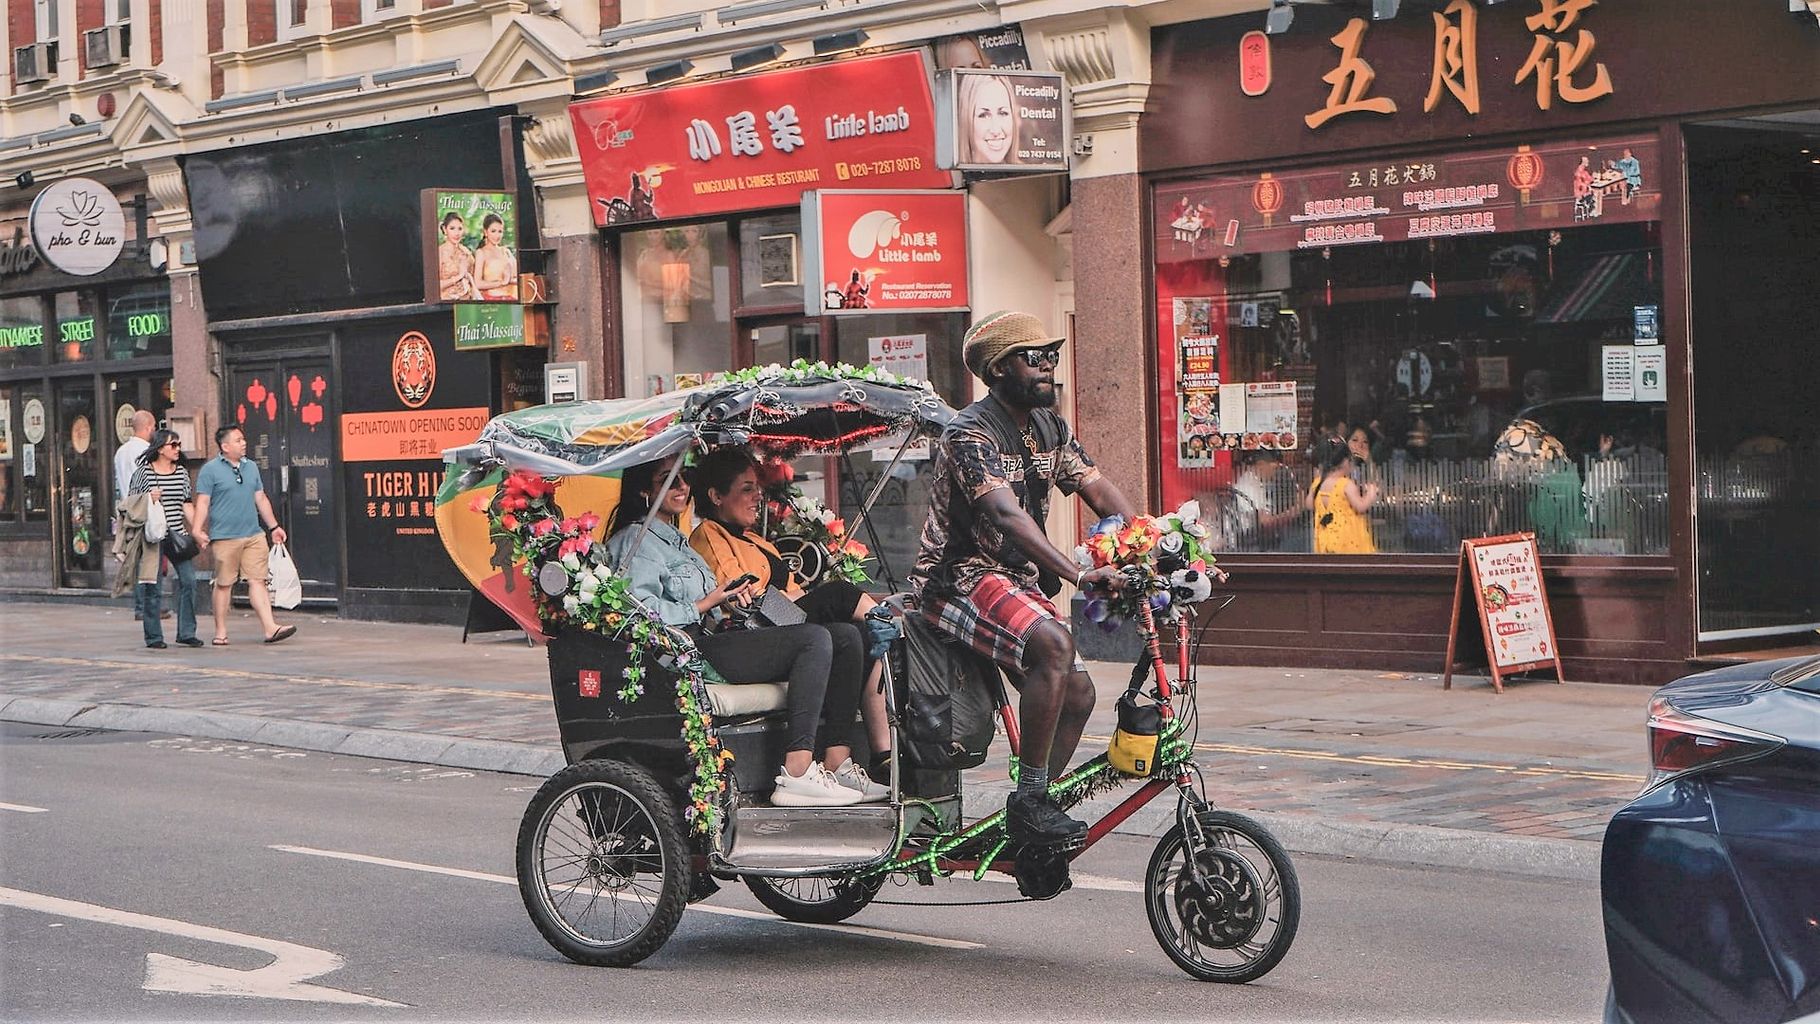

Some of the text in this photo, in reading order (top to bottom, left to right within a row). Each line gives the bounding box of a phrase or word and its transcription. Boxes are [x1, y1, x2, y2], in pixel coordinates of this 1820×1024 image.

[978, 30, 1022, 49] Piccadilly
[1304, 0, 1613, 129] 五月花
[1015, 84, 1059, 100] Piccadilly
[825, 106, 910, 140] Little lamb
[1020, 107, 1056, 119] Dental
[1032, 137, 1046, 147] Tel:
[1031, 150, 1045, 158] 7437
[850, 157, 921, 178] 020-7287 8078
[1348, 164, 1437, 188] 五月花火鍋
[693, 168, 820, 195] MONGOLIAN & CHINESE RESTURANT
[440, 195, 464, 209] Thai
[48, 229, 116, 250] pho & bun
[879, 249, 941, 262] Little lamb
[916, 283, 952, 291] Reservation
[0, 313, 161, 348] TNAMESE STREET FOOD
[457, 320, 524, 343] Thai Massage
[347, 416, 489, 436] CHINATOWN OPENING SOON
[400, 438, 437, 455] 即将开业
[364, 472, 413, 498] TIGER
